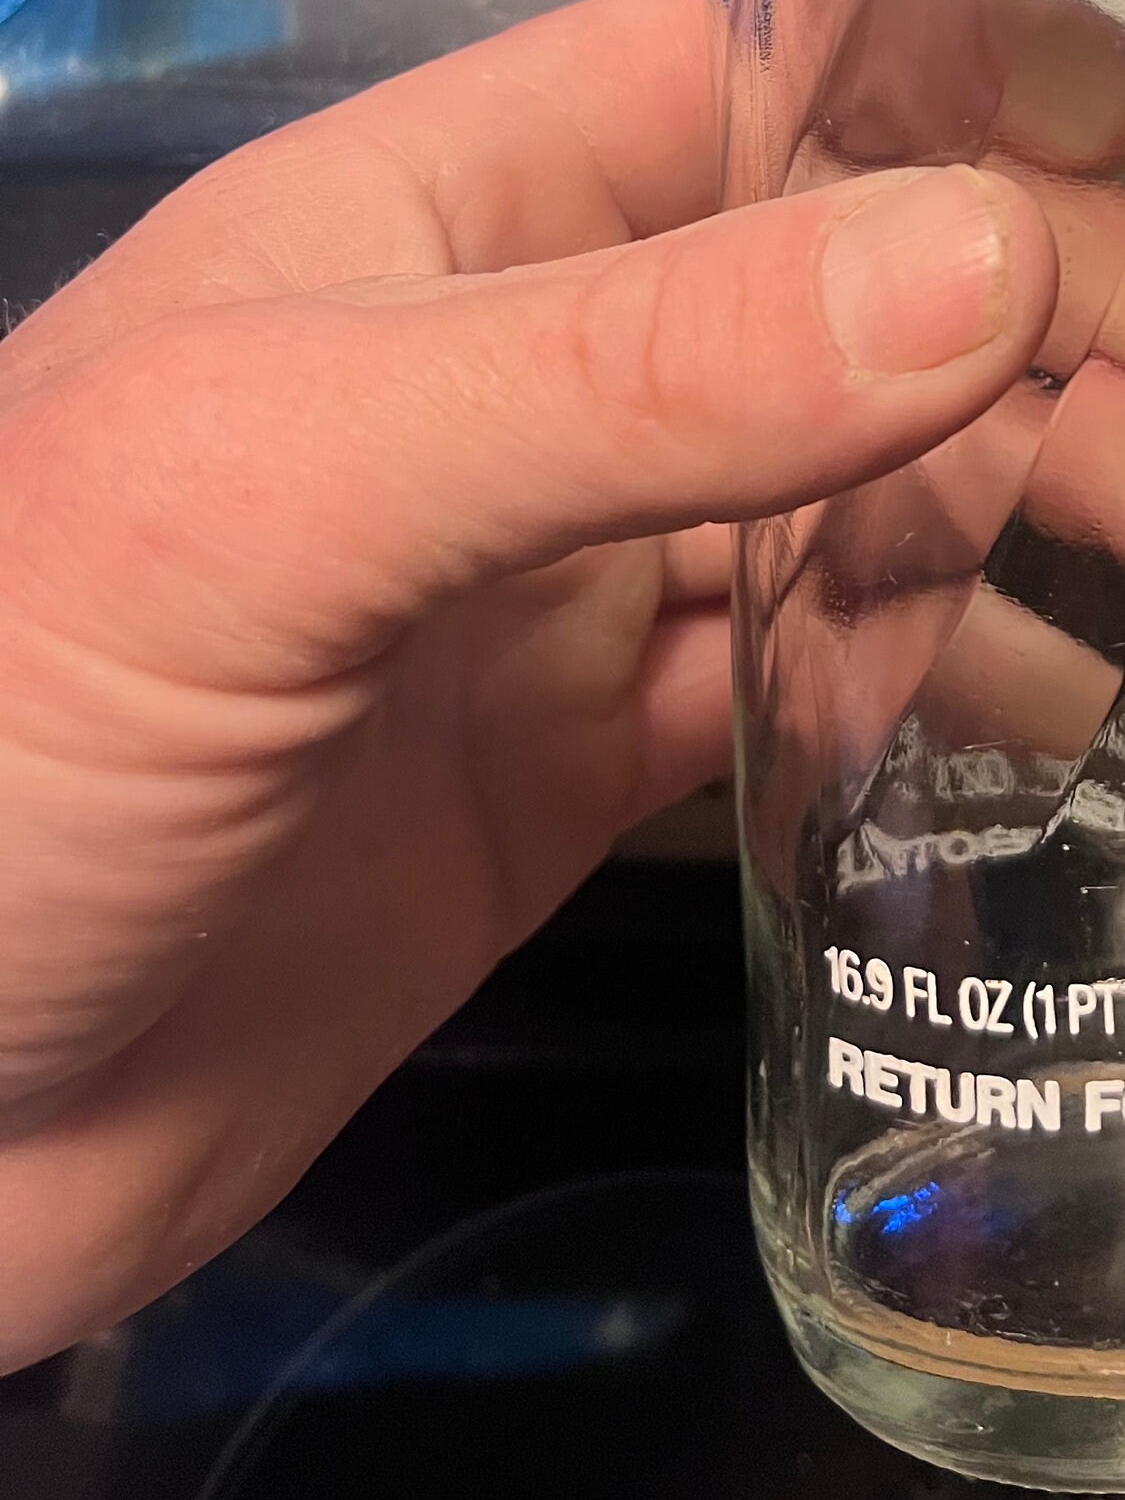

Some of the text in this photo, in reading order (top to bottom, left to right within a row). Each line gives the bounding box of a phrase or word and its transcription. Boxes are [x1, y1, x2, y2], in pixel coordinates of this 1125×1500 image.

[823, 945, 894, 1011] 16.9
[903, 966, 952, 1027] FL
[959, 976, 1015, 1033] OZ
[1067, 983, 1115, 1035] PT
[828, 1035, 1061, 1131] RETURN
